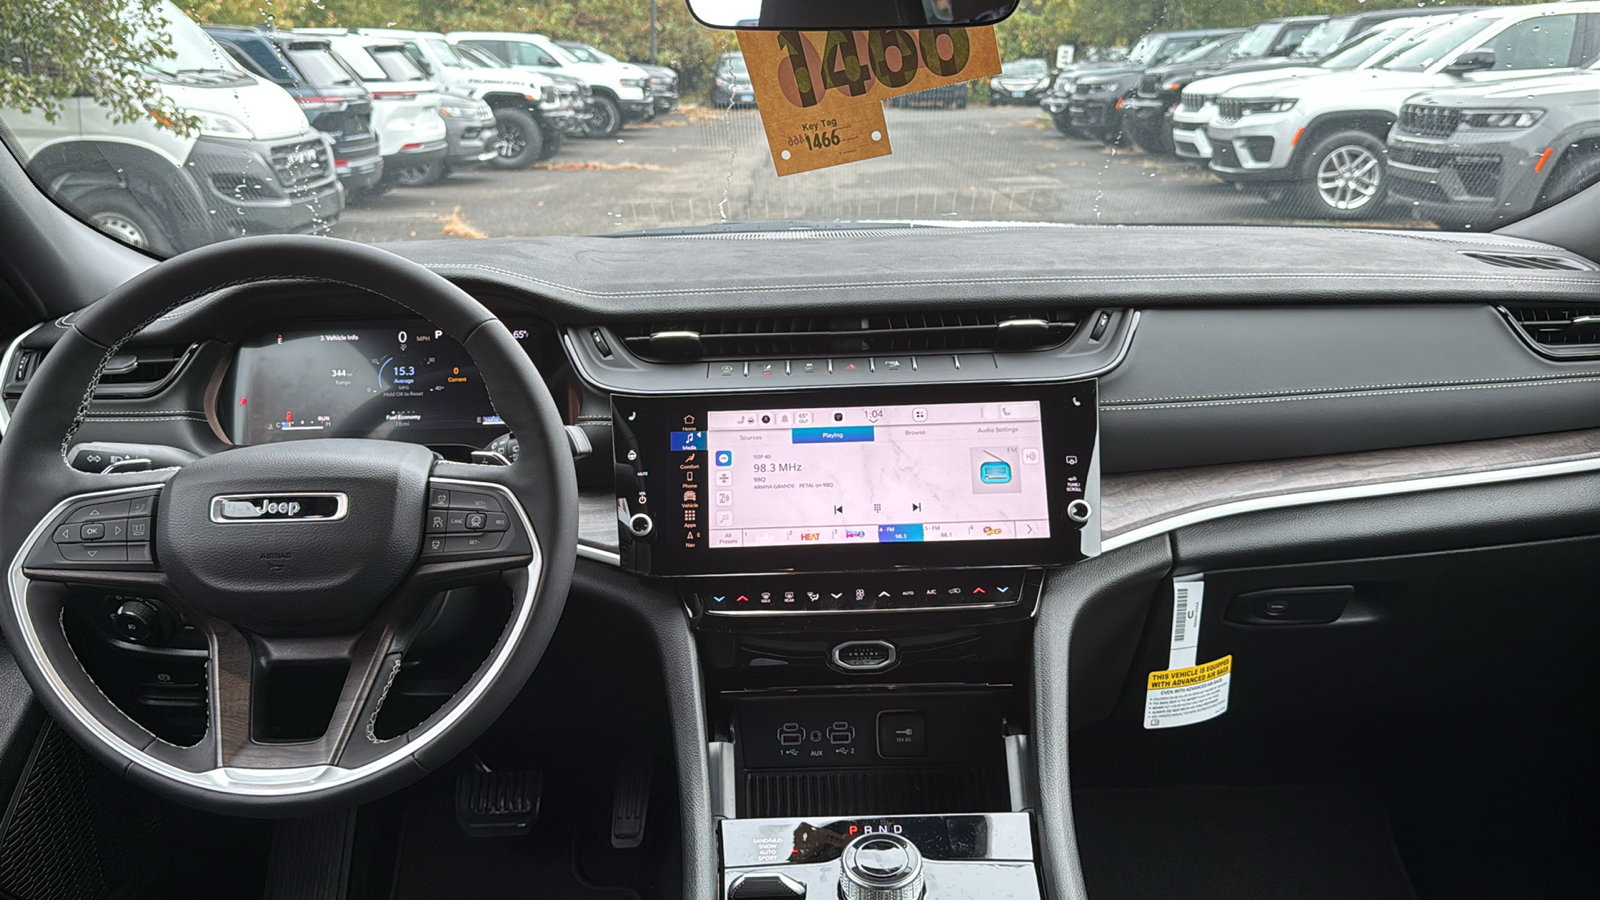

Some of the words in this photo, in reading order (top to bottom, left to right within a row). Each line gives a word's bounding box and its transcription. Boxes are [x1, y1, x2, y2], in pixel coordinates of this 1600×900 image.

[802, 123, 818, 131] Key
[820, 119, 837, 127] Tag
[806, 129, 840, 151] 1466
[398, 330, 407, 343] 0
[435, 330, 442, 339] P
[394, 367, 415, 376] 15.3
[865, 410, 883, 418] 1:04
[753, 463, 776, 473] 98.3
[779, 463, 802, 471] MHz
[256, 500, 300, 516] Jeep
[1188, 610, 1194, 619] U
[1171, 669, 1198, 679] VEHICLE
[1206, 659, 1230, 671] EQUIPPED
[1172, 675, 1206, 686] ADVANCED
[1217, 666, 1229, 675] BAGS
[1186, 683, 1207, 692] ADVANCED
[850, 826, 858, 835] P
[864, 826, 872, 834] R
[894, 825, 902, 834] D
